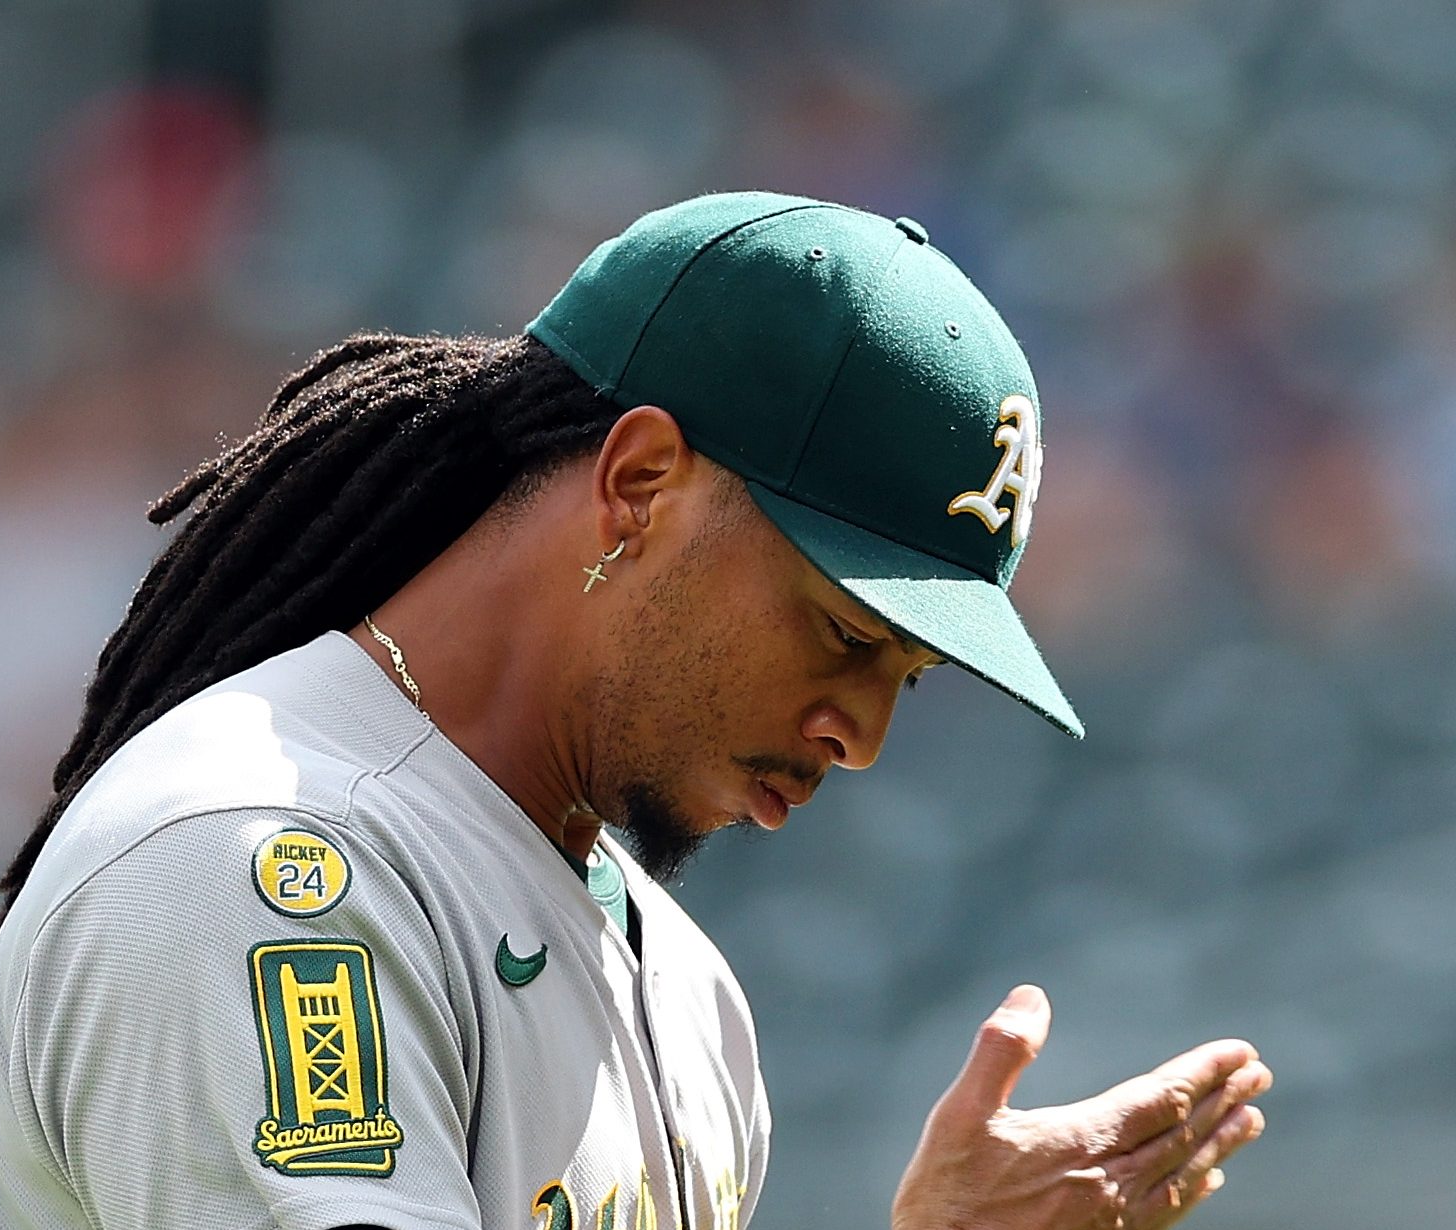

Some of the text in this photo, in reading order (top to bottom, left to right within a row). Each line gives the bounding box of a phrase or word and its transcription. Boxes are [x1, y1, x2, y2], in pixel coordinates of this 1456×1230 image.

[273, 844, 327, 862] RICKEY
[278, 863, 326, 899] 24
[256, 1108, 401, 1151] Sacramento
